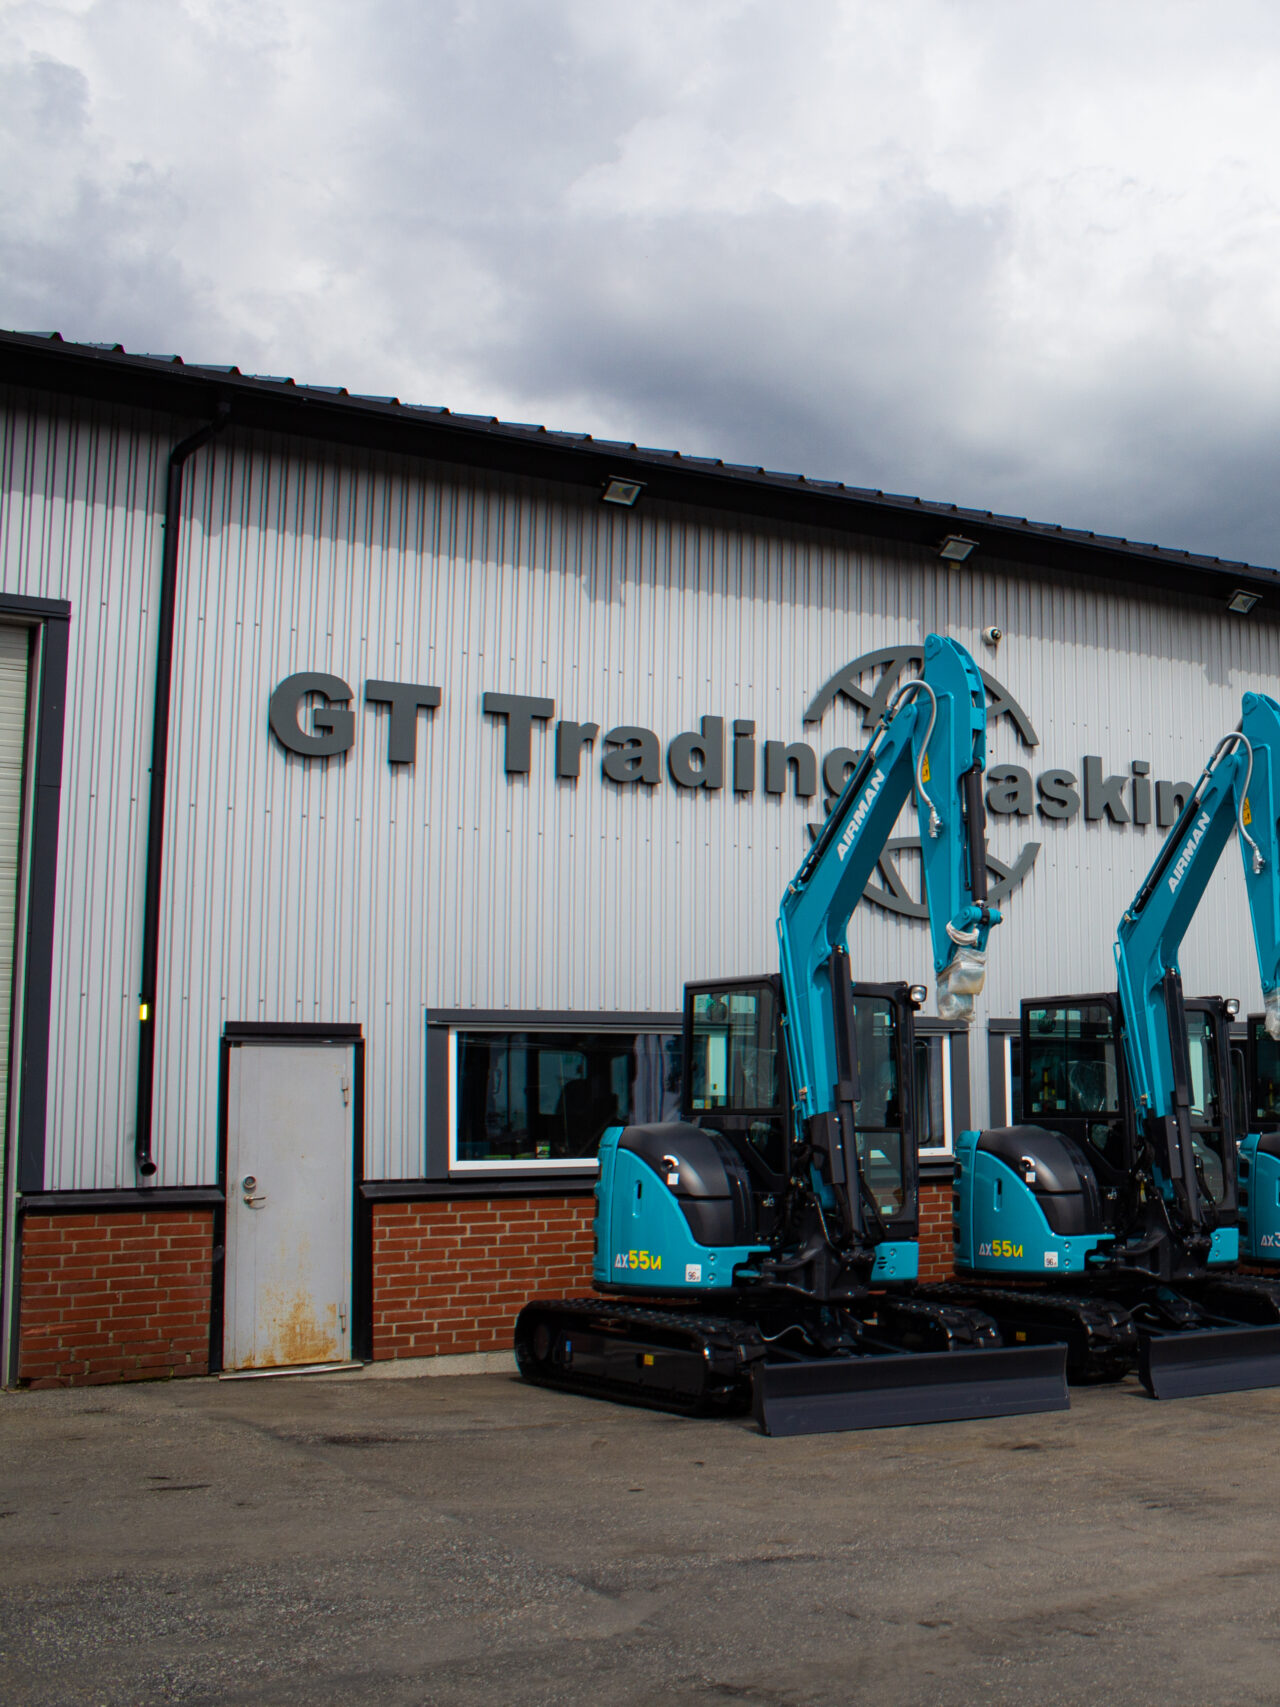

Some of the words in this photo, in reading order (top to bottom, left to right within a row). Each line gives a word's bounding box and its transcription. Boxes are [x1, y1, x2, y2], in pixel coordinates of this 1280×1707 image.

[268, 671, 441, 764] GT
[836, 768, 886, 862] AIRMAN
[1167, 811, 1211, 894] AIRMAN
